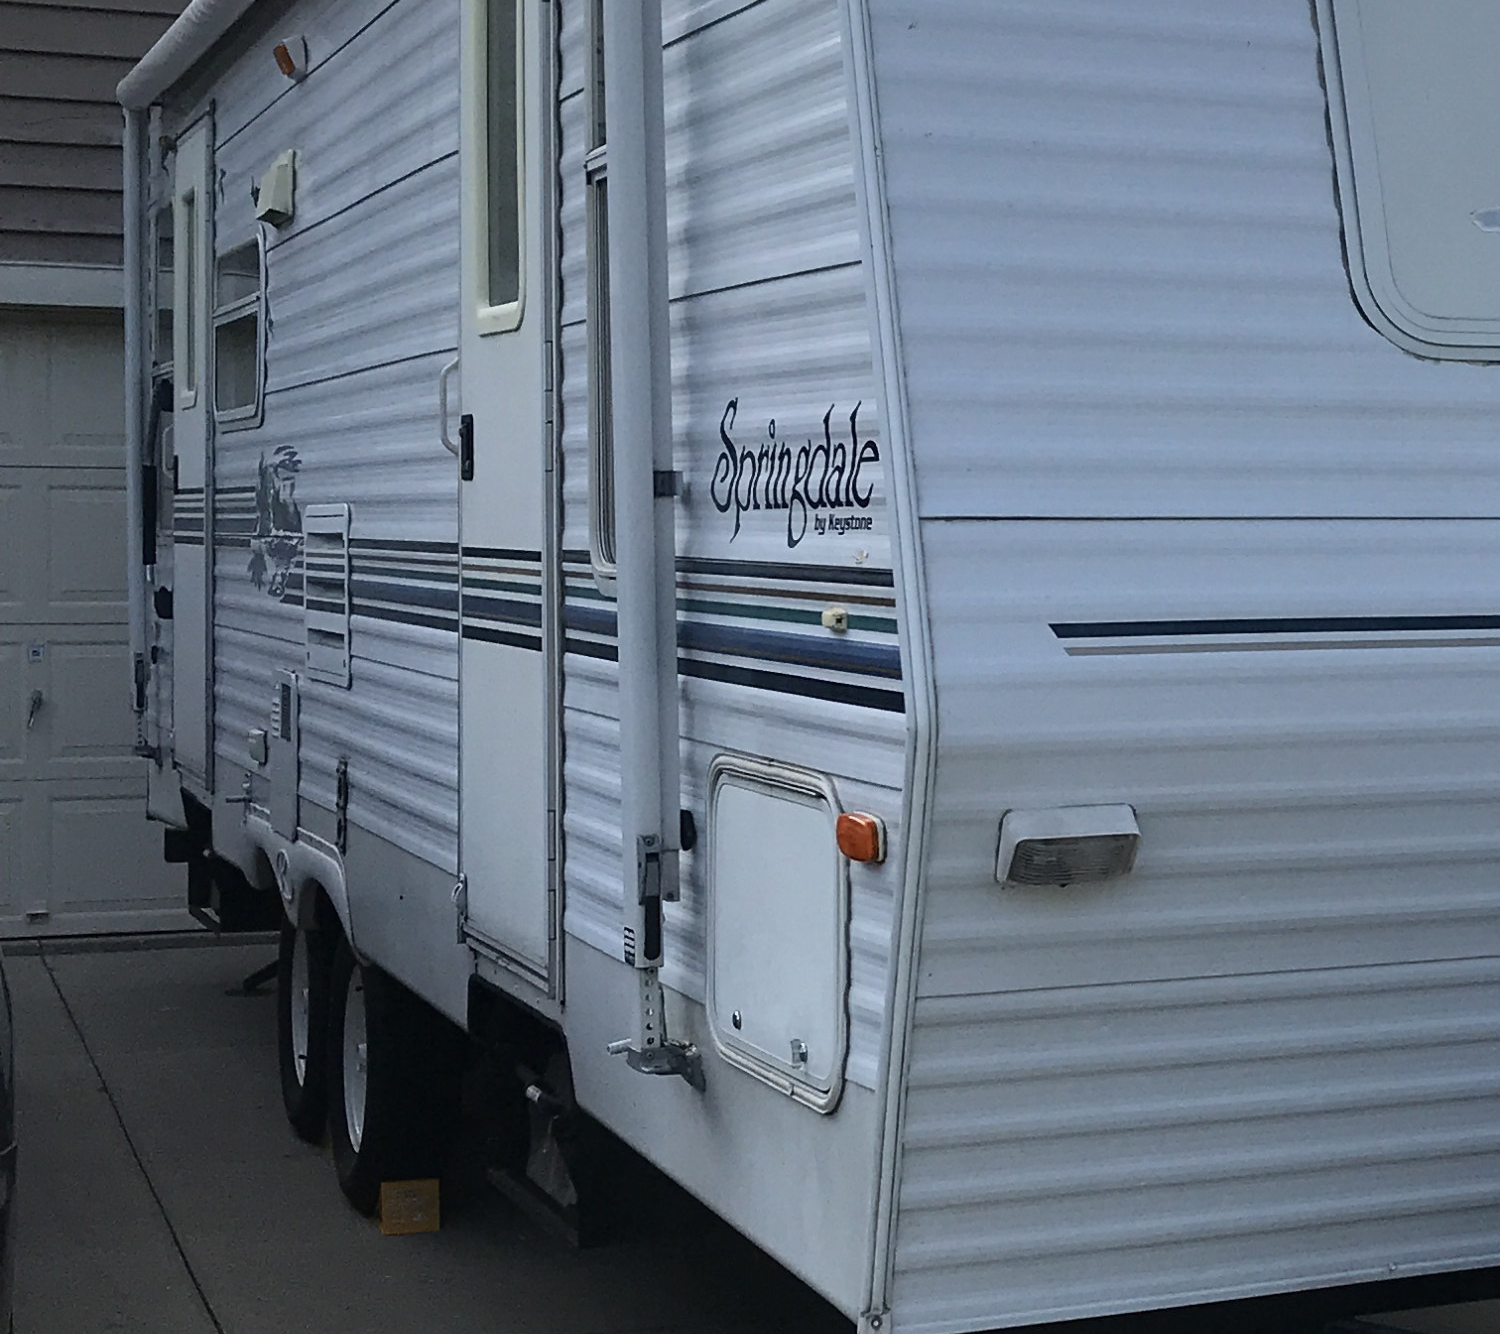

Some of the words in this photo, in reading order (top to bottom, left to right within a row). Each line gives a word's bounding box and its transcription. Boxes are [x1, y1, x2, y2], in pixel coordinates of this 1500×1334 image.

[711, 397, 880, 548] Springdale
[814, 513, 826, 535] by
[828, 513, 873, 535] Keystone
